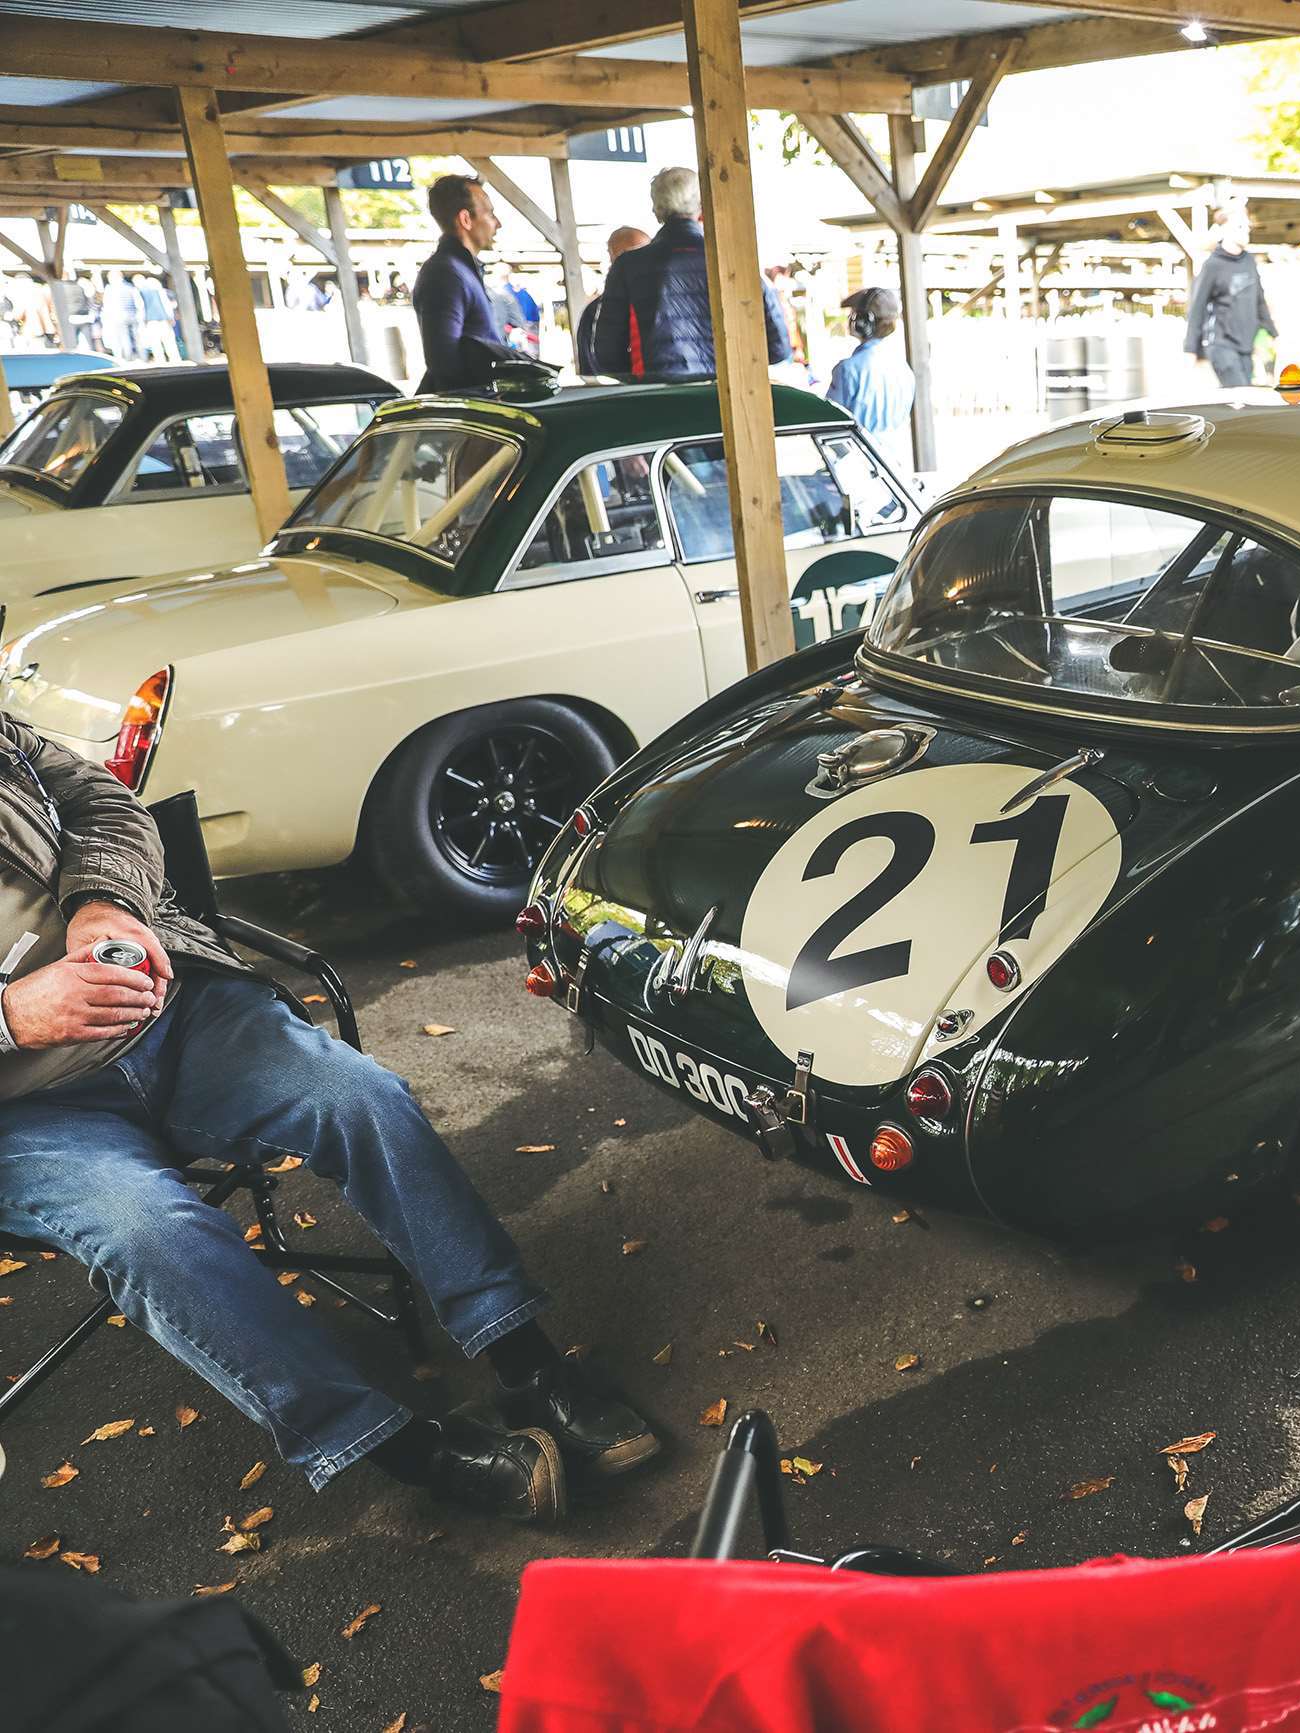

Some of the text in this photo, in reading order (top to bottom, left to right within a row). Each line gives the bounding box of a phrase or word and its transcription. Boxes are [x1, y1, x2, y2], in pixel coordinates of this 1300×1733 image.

[607, 126, 644, 153] 111
[369, 158, 413, 183] 112
[785, 794, 1071, 1012] 21
[627, 1024, 681, 1089] DD
